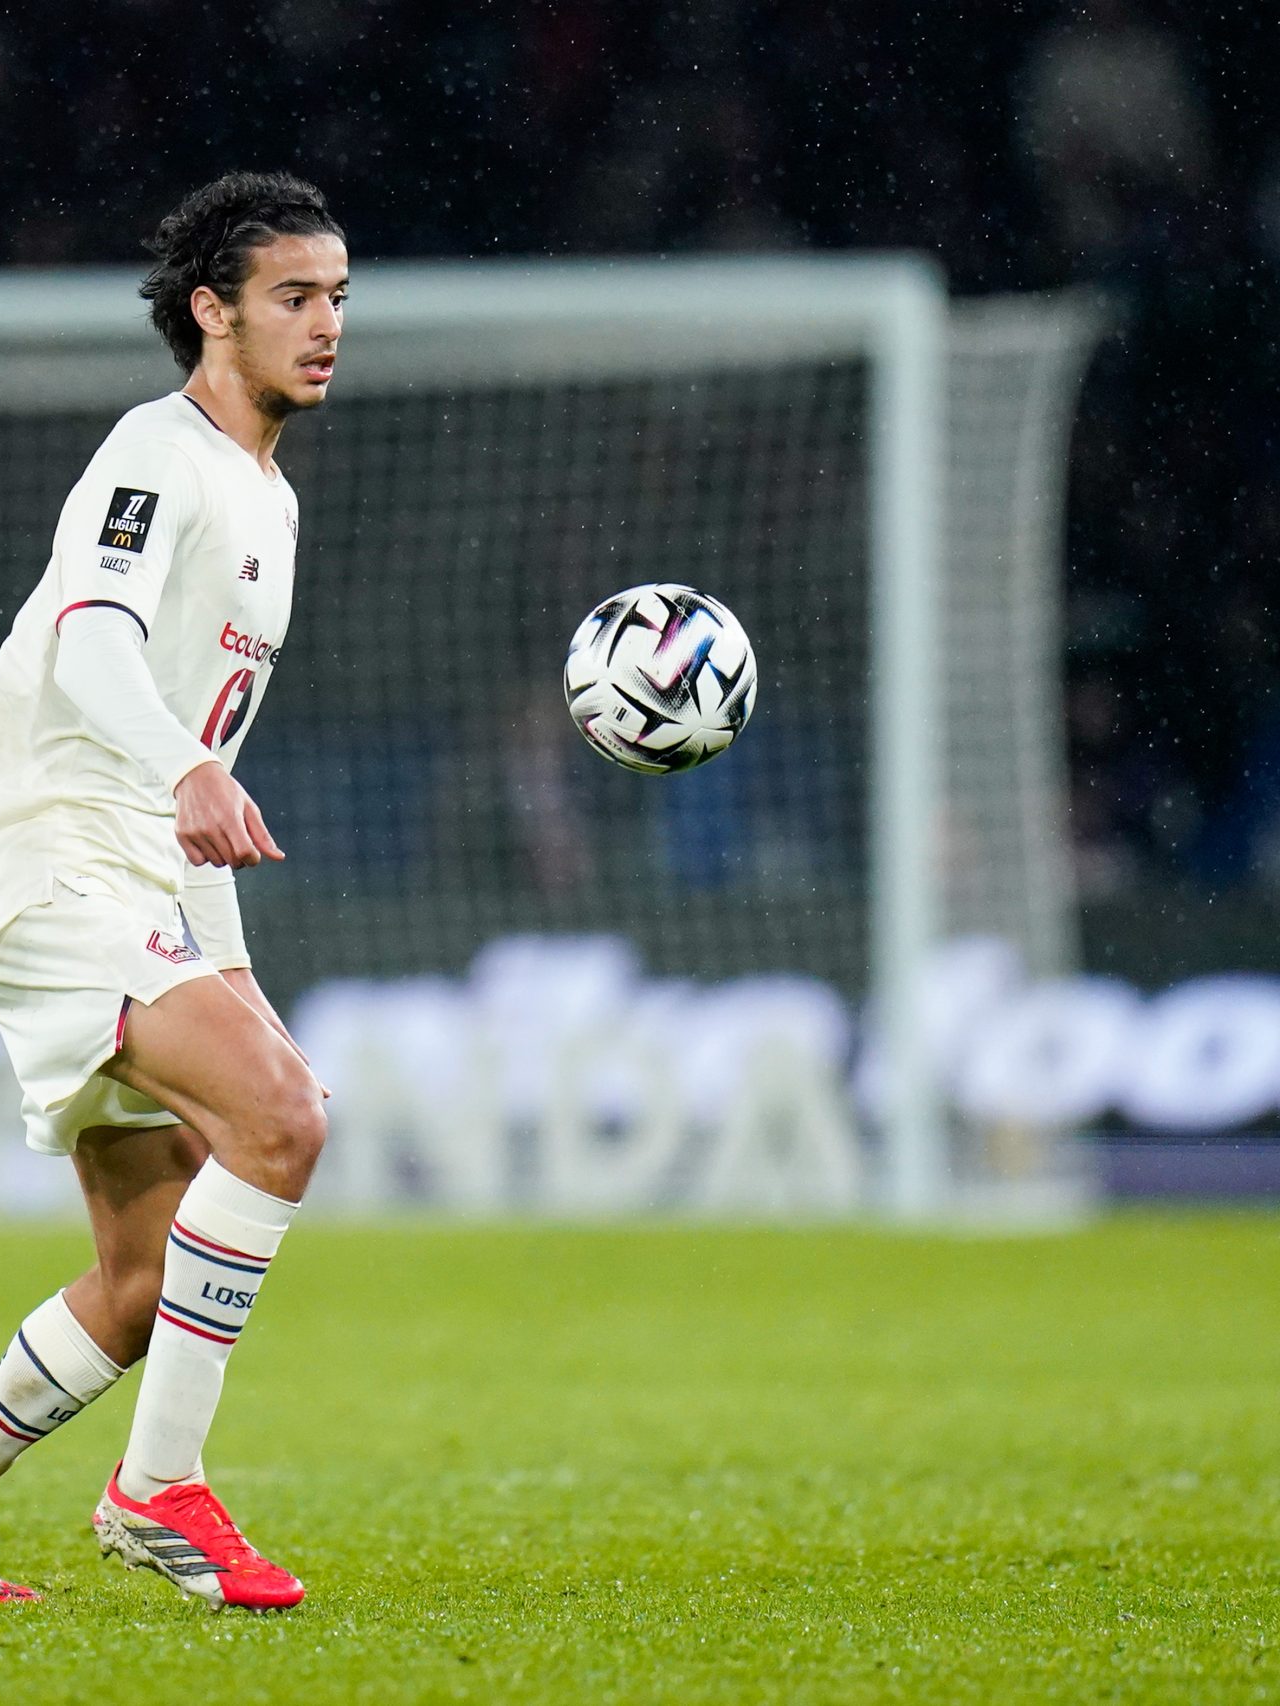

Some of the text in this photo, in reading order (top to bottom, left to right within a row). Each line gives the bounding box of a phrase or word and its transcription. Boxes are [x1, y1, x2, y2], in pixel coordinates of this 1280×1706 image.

[108, 516, 147, 535] LIGUE 1
[594, 727, 624, 753] KIPSTA
